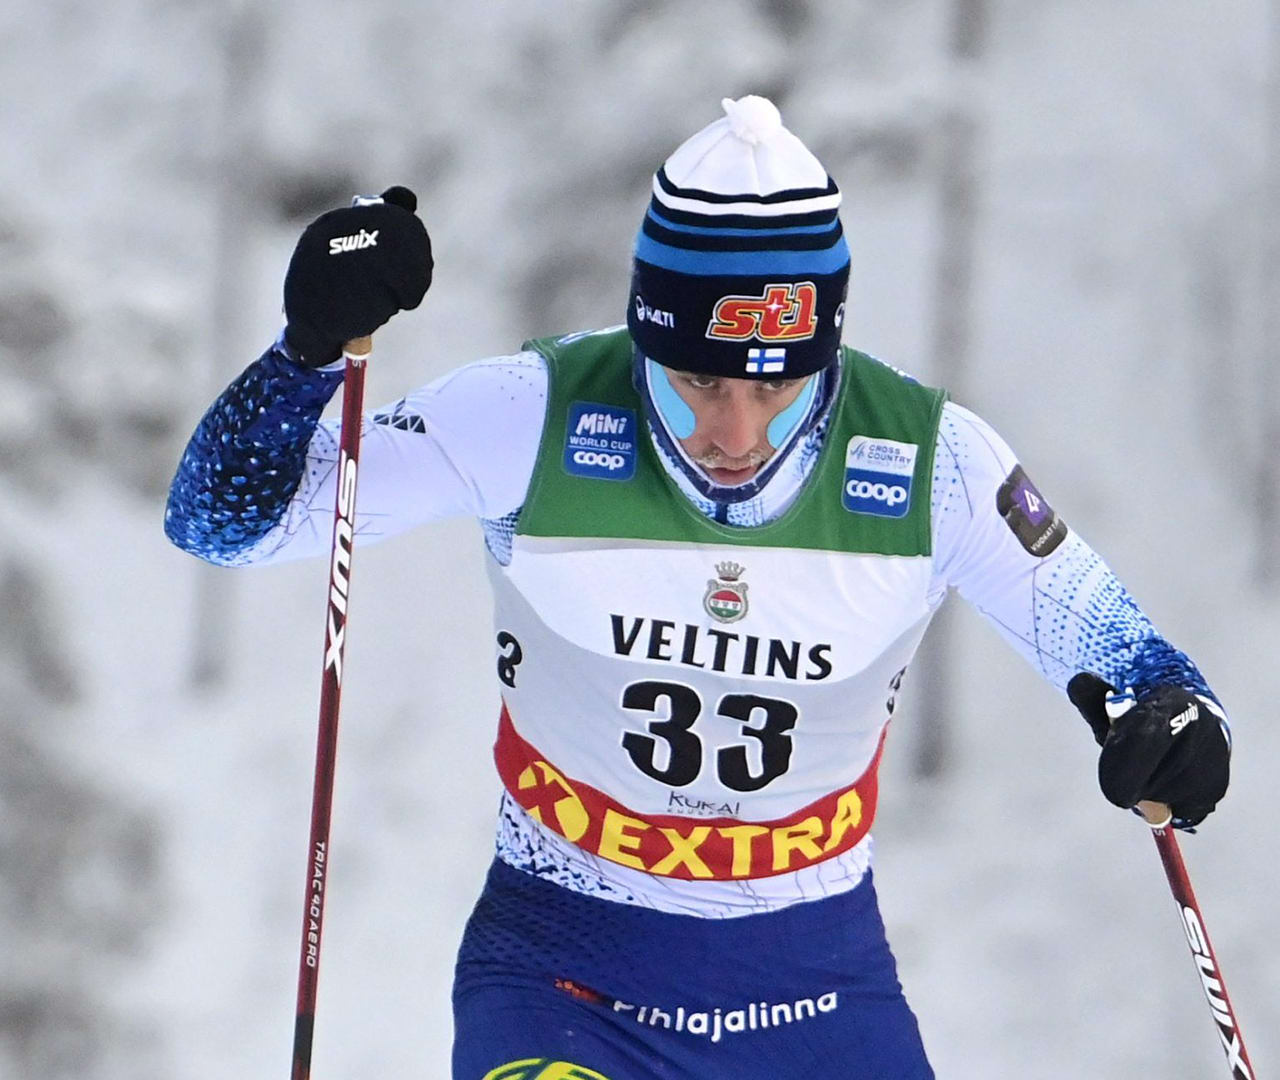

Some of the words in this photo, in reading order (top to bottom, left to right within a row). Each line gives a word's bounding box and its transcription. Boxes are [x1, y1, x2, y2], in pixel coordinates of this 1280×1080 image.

[646, 306, 674, 328] HALTI
[569, 436, 608, 448] WORLD
[610, 440, 632, 450] CUP
[868, 444, 901, 455] CROSS
[573, 451, 625, 470] coop
[867, 451, 912, 464] COUNTRY
[846, 479, 907, 507] coop
[610, 613, 833, 680] VELTINS
[622, 680, 798, 792] 33
[597, 788, 863, 879] EXTRA
[313, 841, 325, 892] TRIAC
[306, 919, 319, 968] AERO
